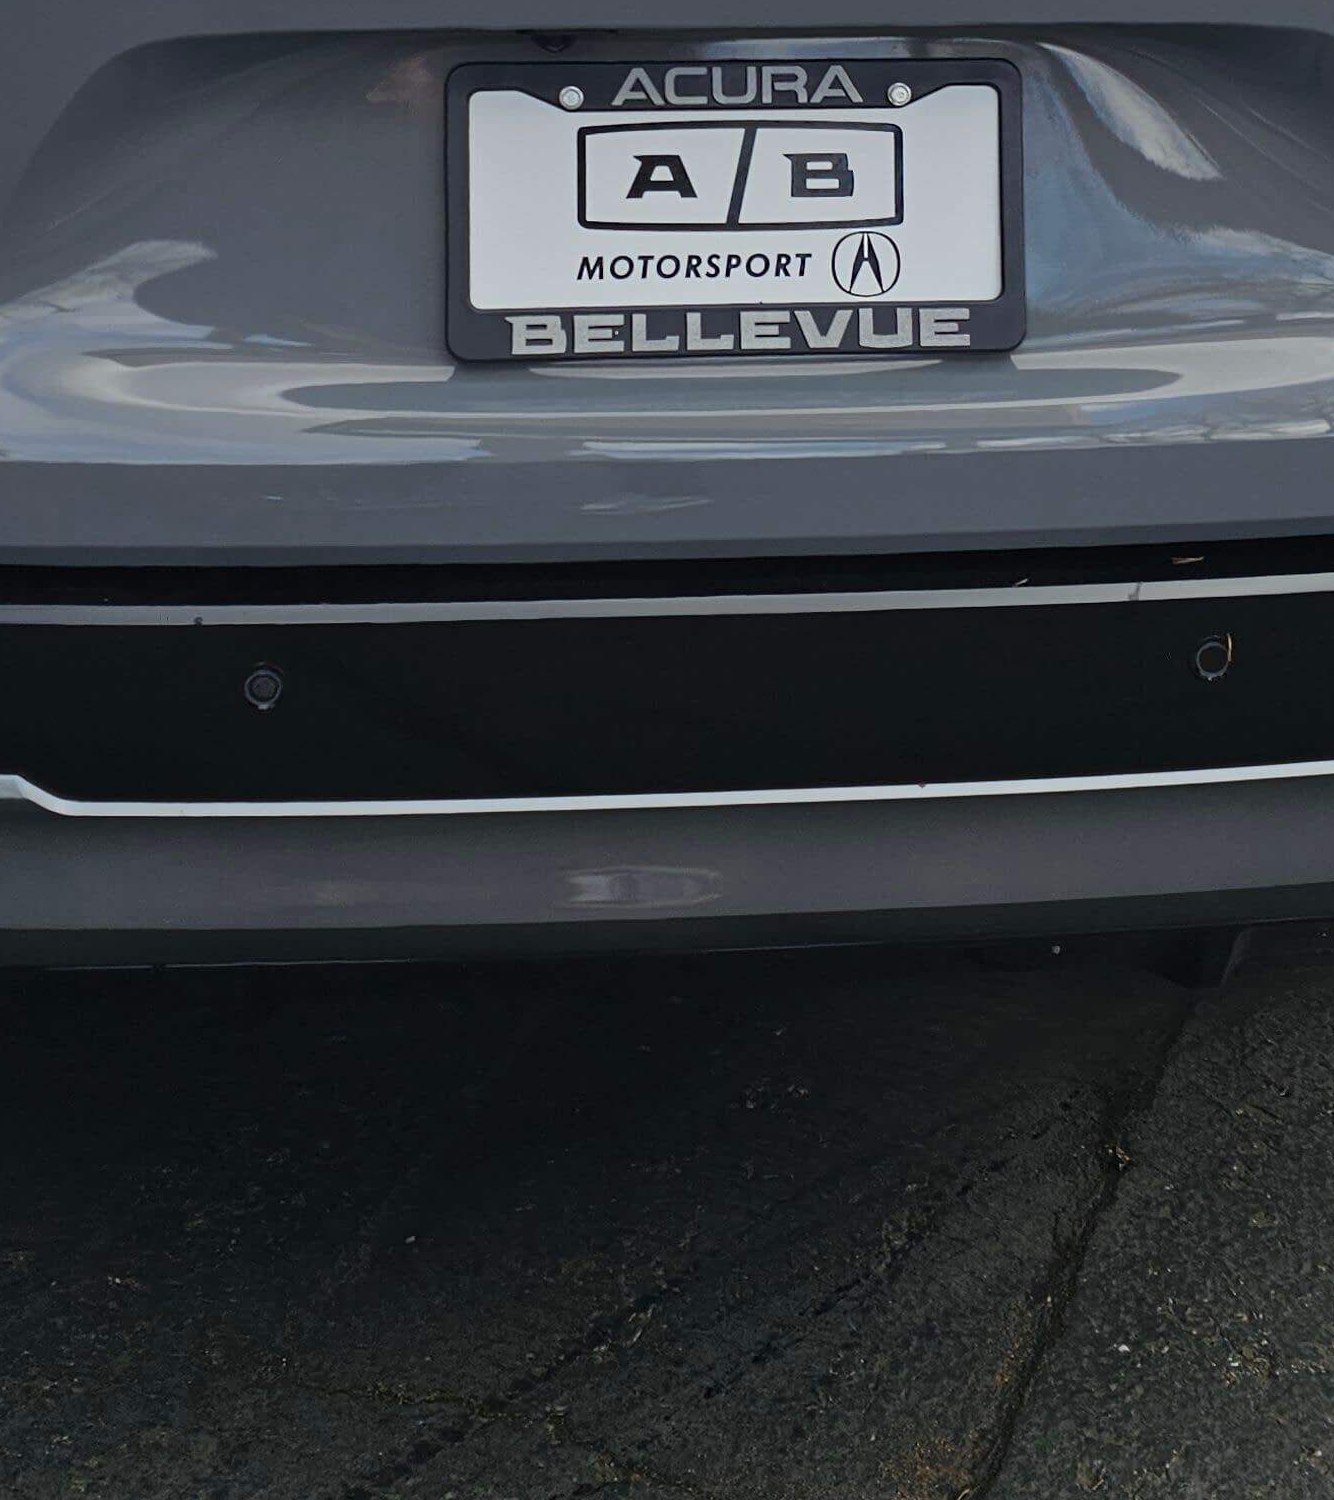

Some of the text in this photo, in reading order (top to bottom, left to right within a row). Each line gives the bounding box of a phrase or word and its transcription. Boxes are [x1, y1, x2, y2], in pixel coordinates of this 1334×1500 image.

[612, 65, 864, 106] ACURA
[576, 252, 813, 281] MOTORSPORT
[504, 307, 971, 356] BELLEVUE
